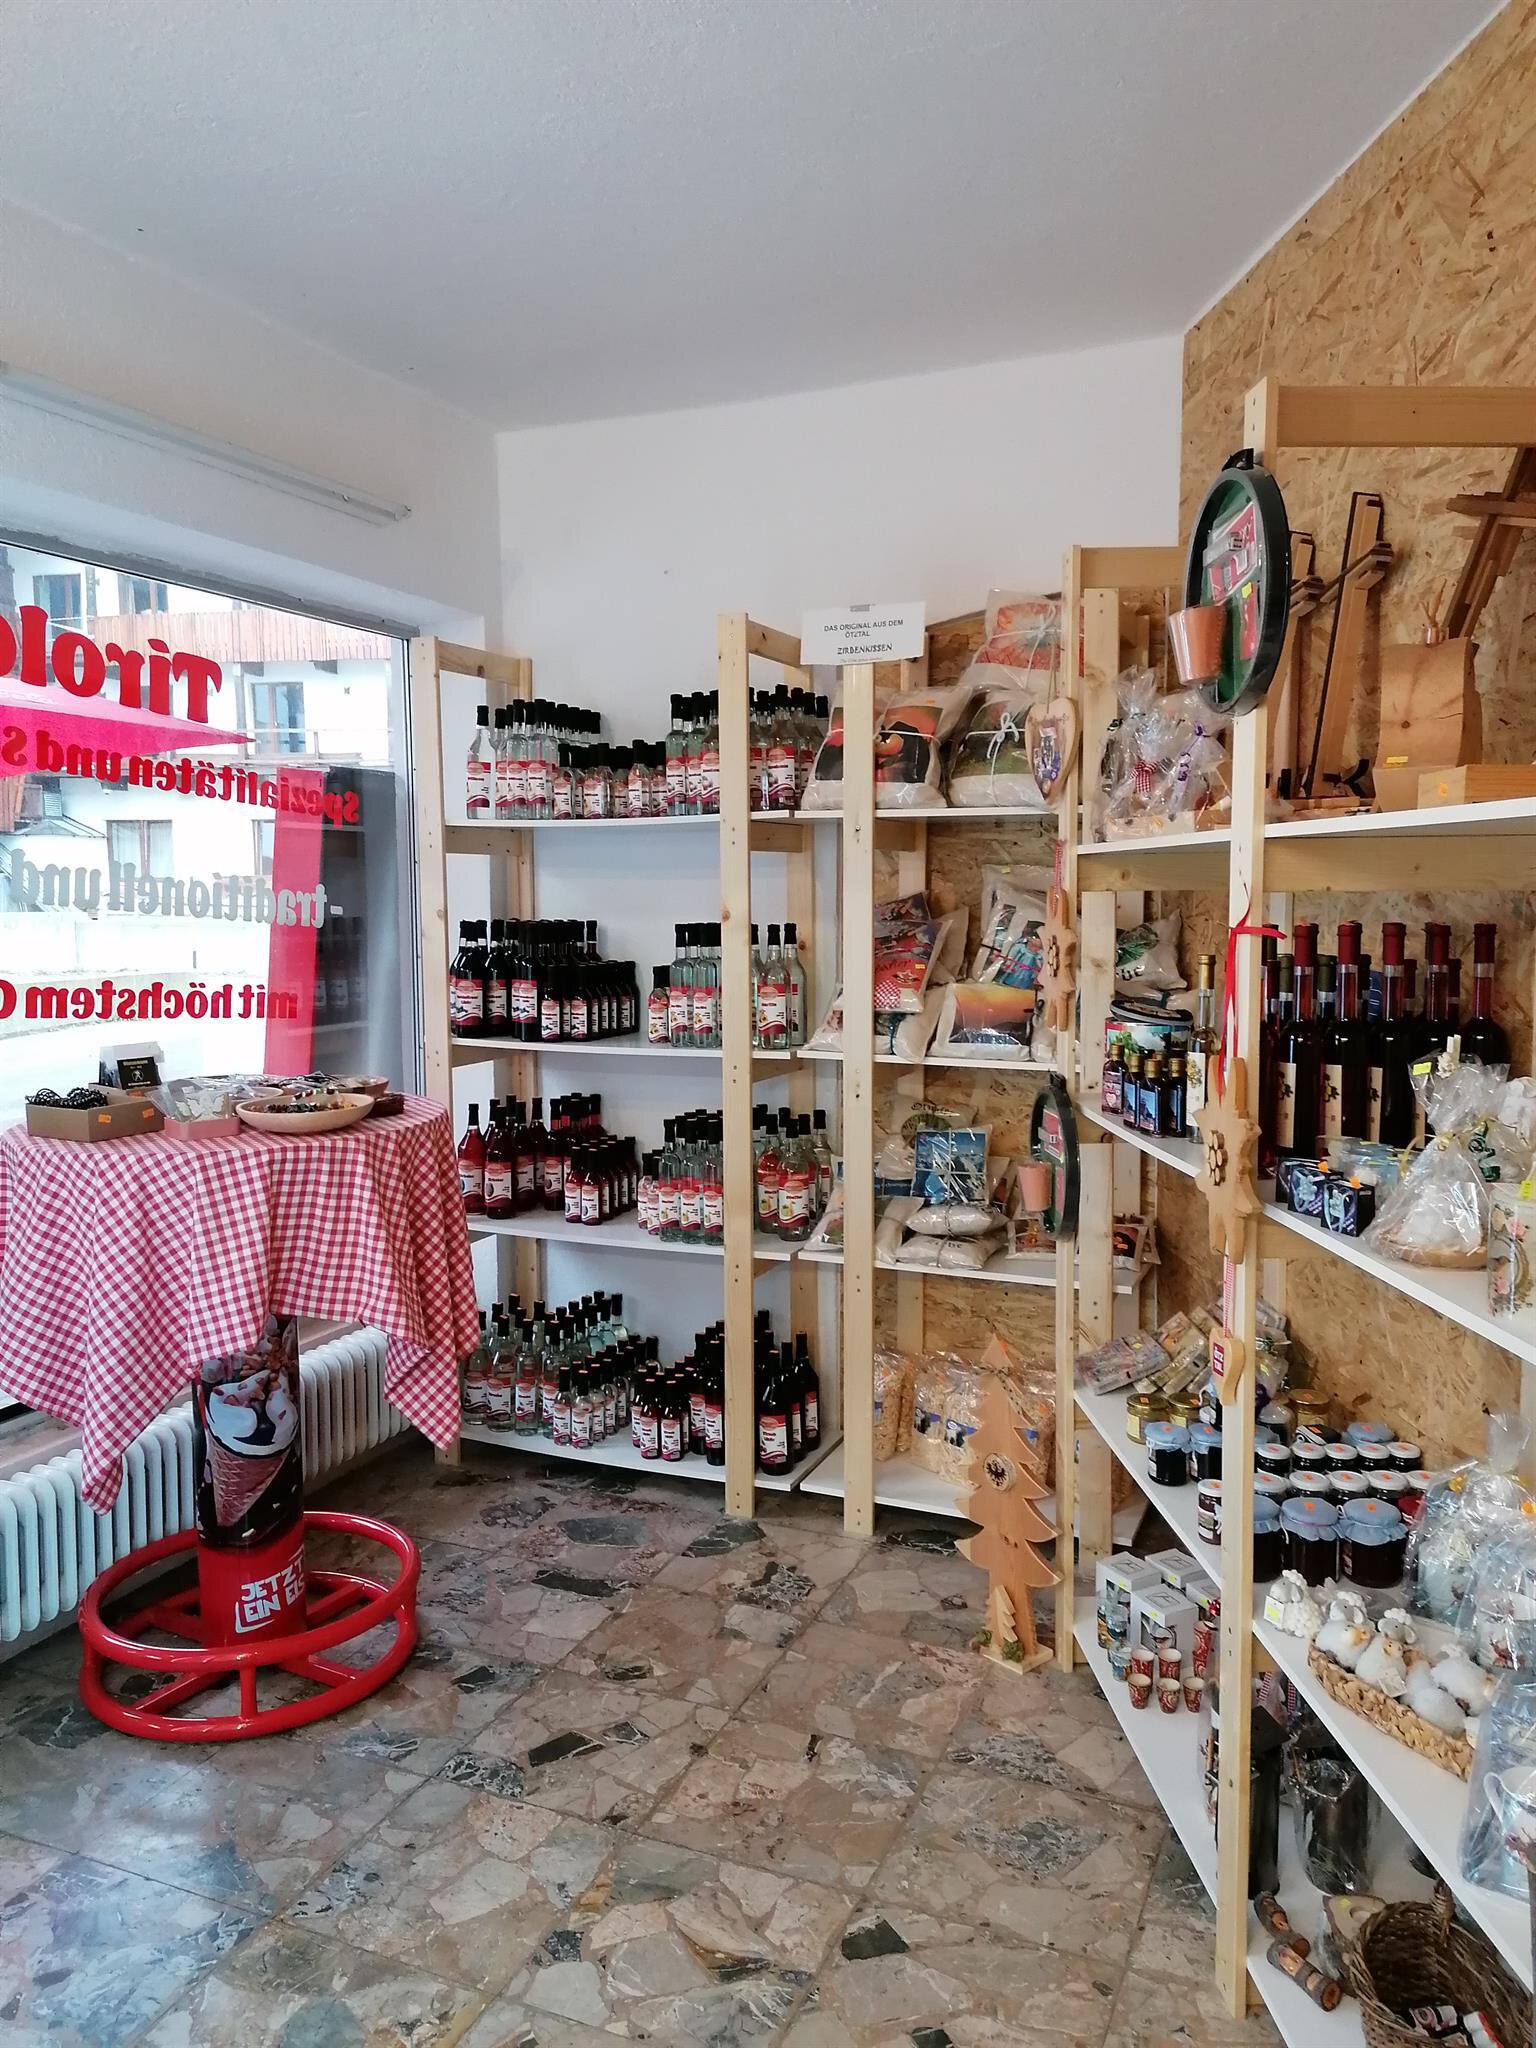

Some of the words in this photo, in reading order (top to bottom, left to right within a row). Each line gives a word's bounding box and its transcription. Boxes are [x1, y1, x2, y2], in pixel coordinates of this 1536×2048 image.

[840, 623, 871, 631] ORIGINAL
[888, 619, 904, 627] DEM
[837, 644, 893, 655] ZIRBENKISSEN
[241, 1555, 303, 1601] JETZT
[244, 1593, 281, 1622] EIN
